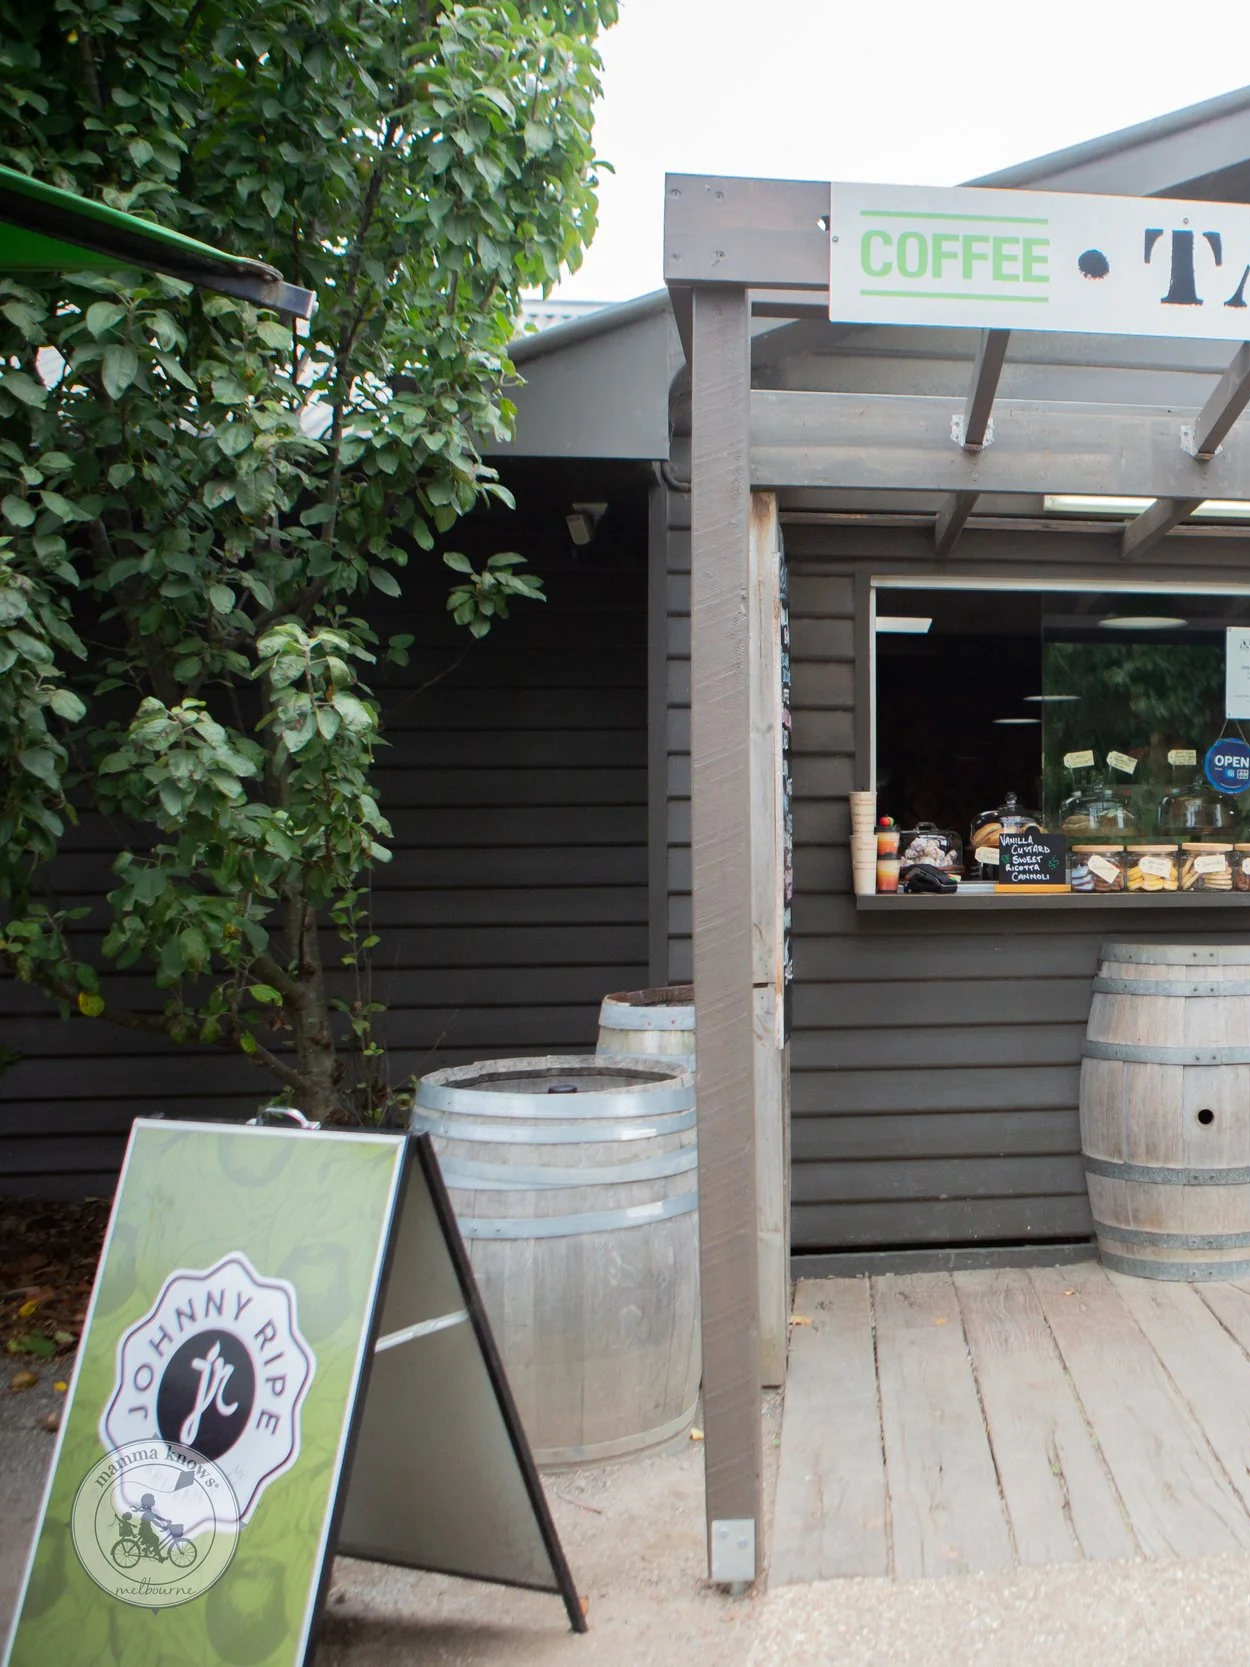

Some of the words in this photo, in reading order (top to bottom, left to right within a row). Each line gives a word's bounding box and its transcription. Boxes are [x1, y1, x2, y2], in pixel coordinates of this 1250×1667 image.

[860, 229, 1050, 283] COFFEE
[1214, 755, 1250, 769] OPEN
[1000, 834, 1034, 846] VANILLA
[1011, 844, 1051, 855] CUSTARD
[1012, 855, 1043, 864] SWEET
[1005, 863, 1041, 872] RICOTTA
[1011, 872, 1050, 882] CANNOLI
[128, 1288, 254, 1420] JOHNNY
[254, 1318, 288, 1435] RIPE
